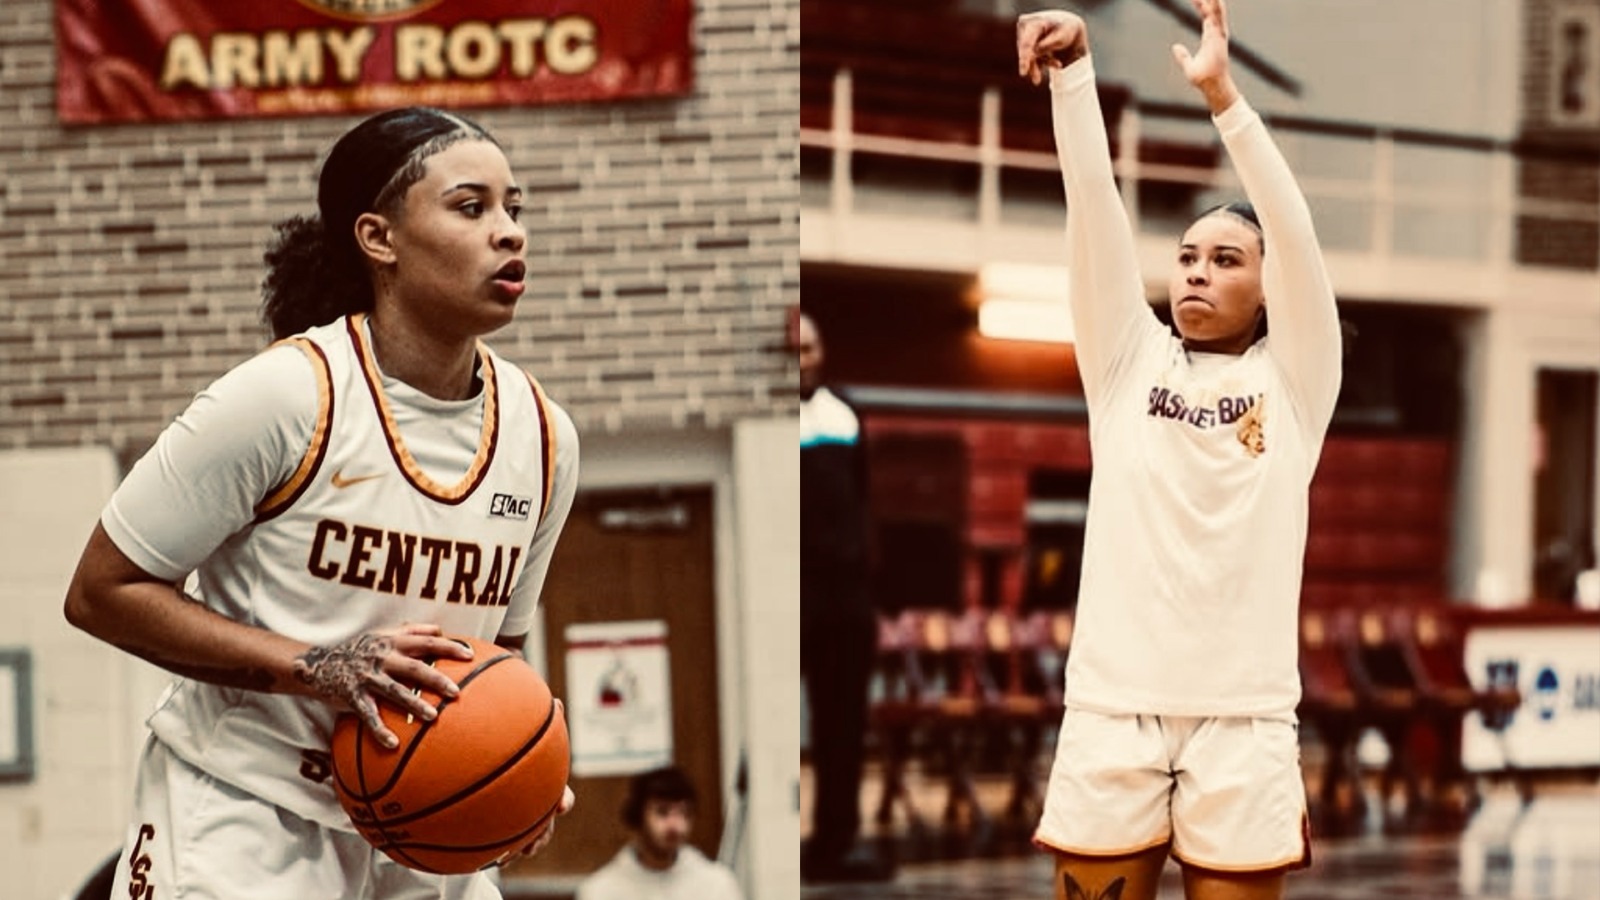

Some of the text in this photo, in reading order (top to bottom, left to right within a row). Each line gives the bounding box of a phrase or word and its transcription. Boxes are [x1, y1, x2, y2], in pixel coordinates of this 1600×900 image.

[161, 16, 597, 91] ARMY ROTC
[307, 518, 522, 607] CENTRAL
